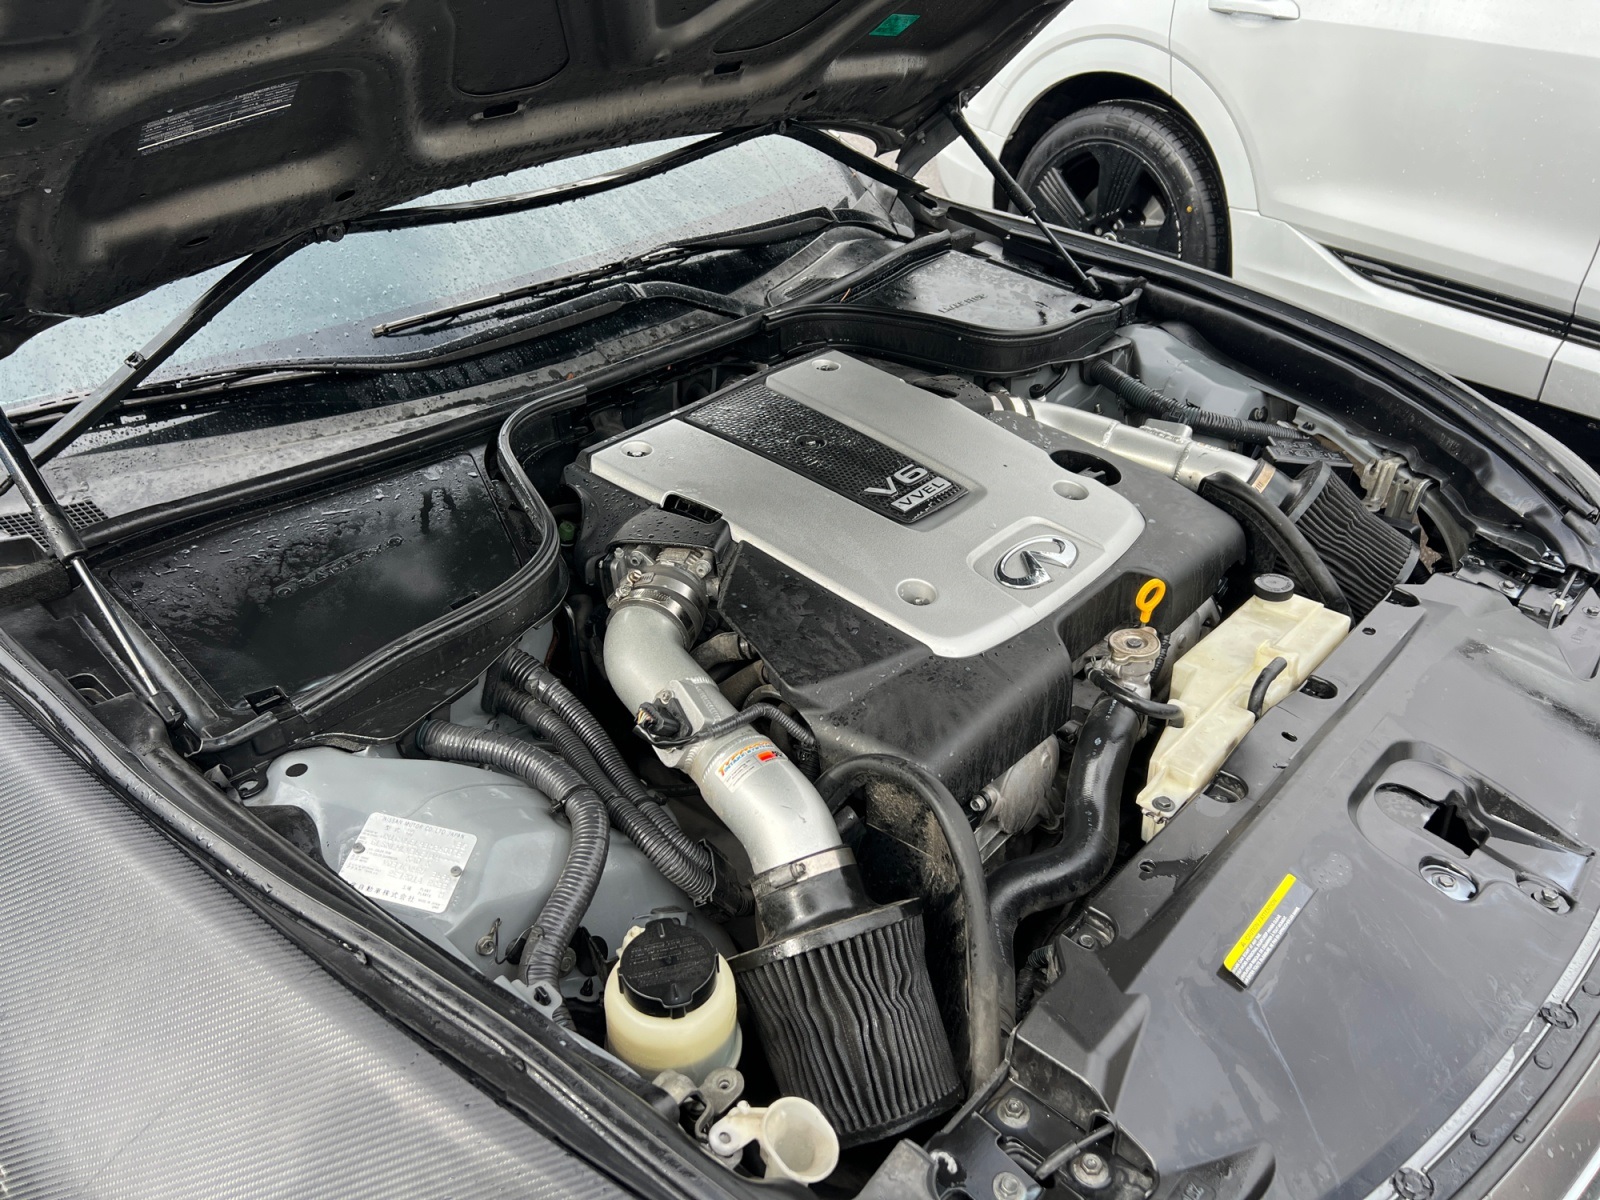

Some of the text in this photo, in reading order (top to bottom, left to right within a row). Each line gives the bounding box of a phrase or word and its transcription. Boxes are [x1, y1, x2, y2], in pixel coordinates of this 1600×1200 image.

[863, 463, 930, 497] V6
[897, 481, 947, 507] VVEL
[383, 815, 402, 825] NISSAN
[404, 820, 424, 830] MOTOR
